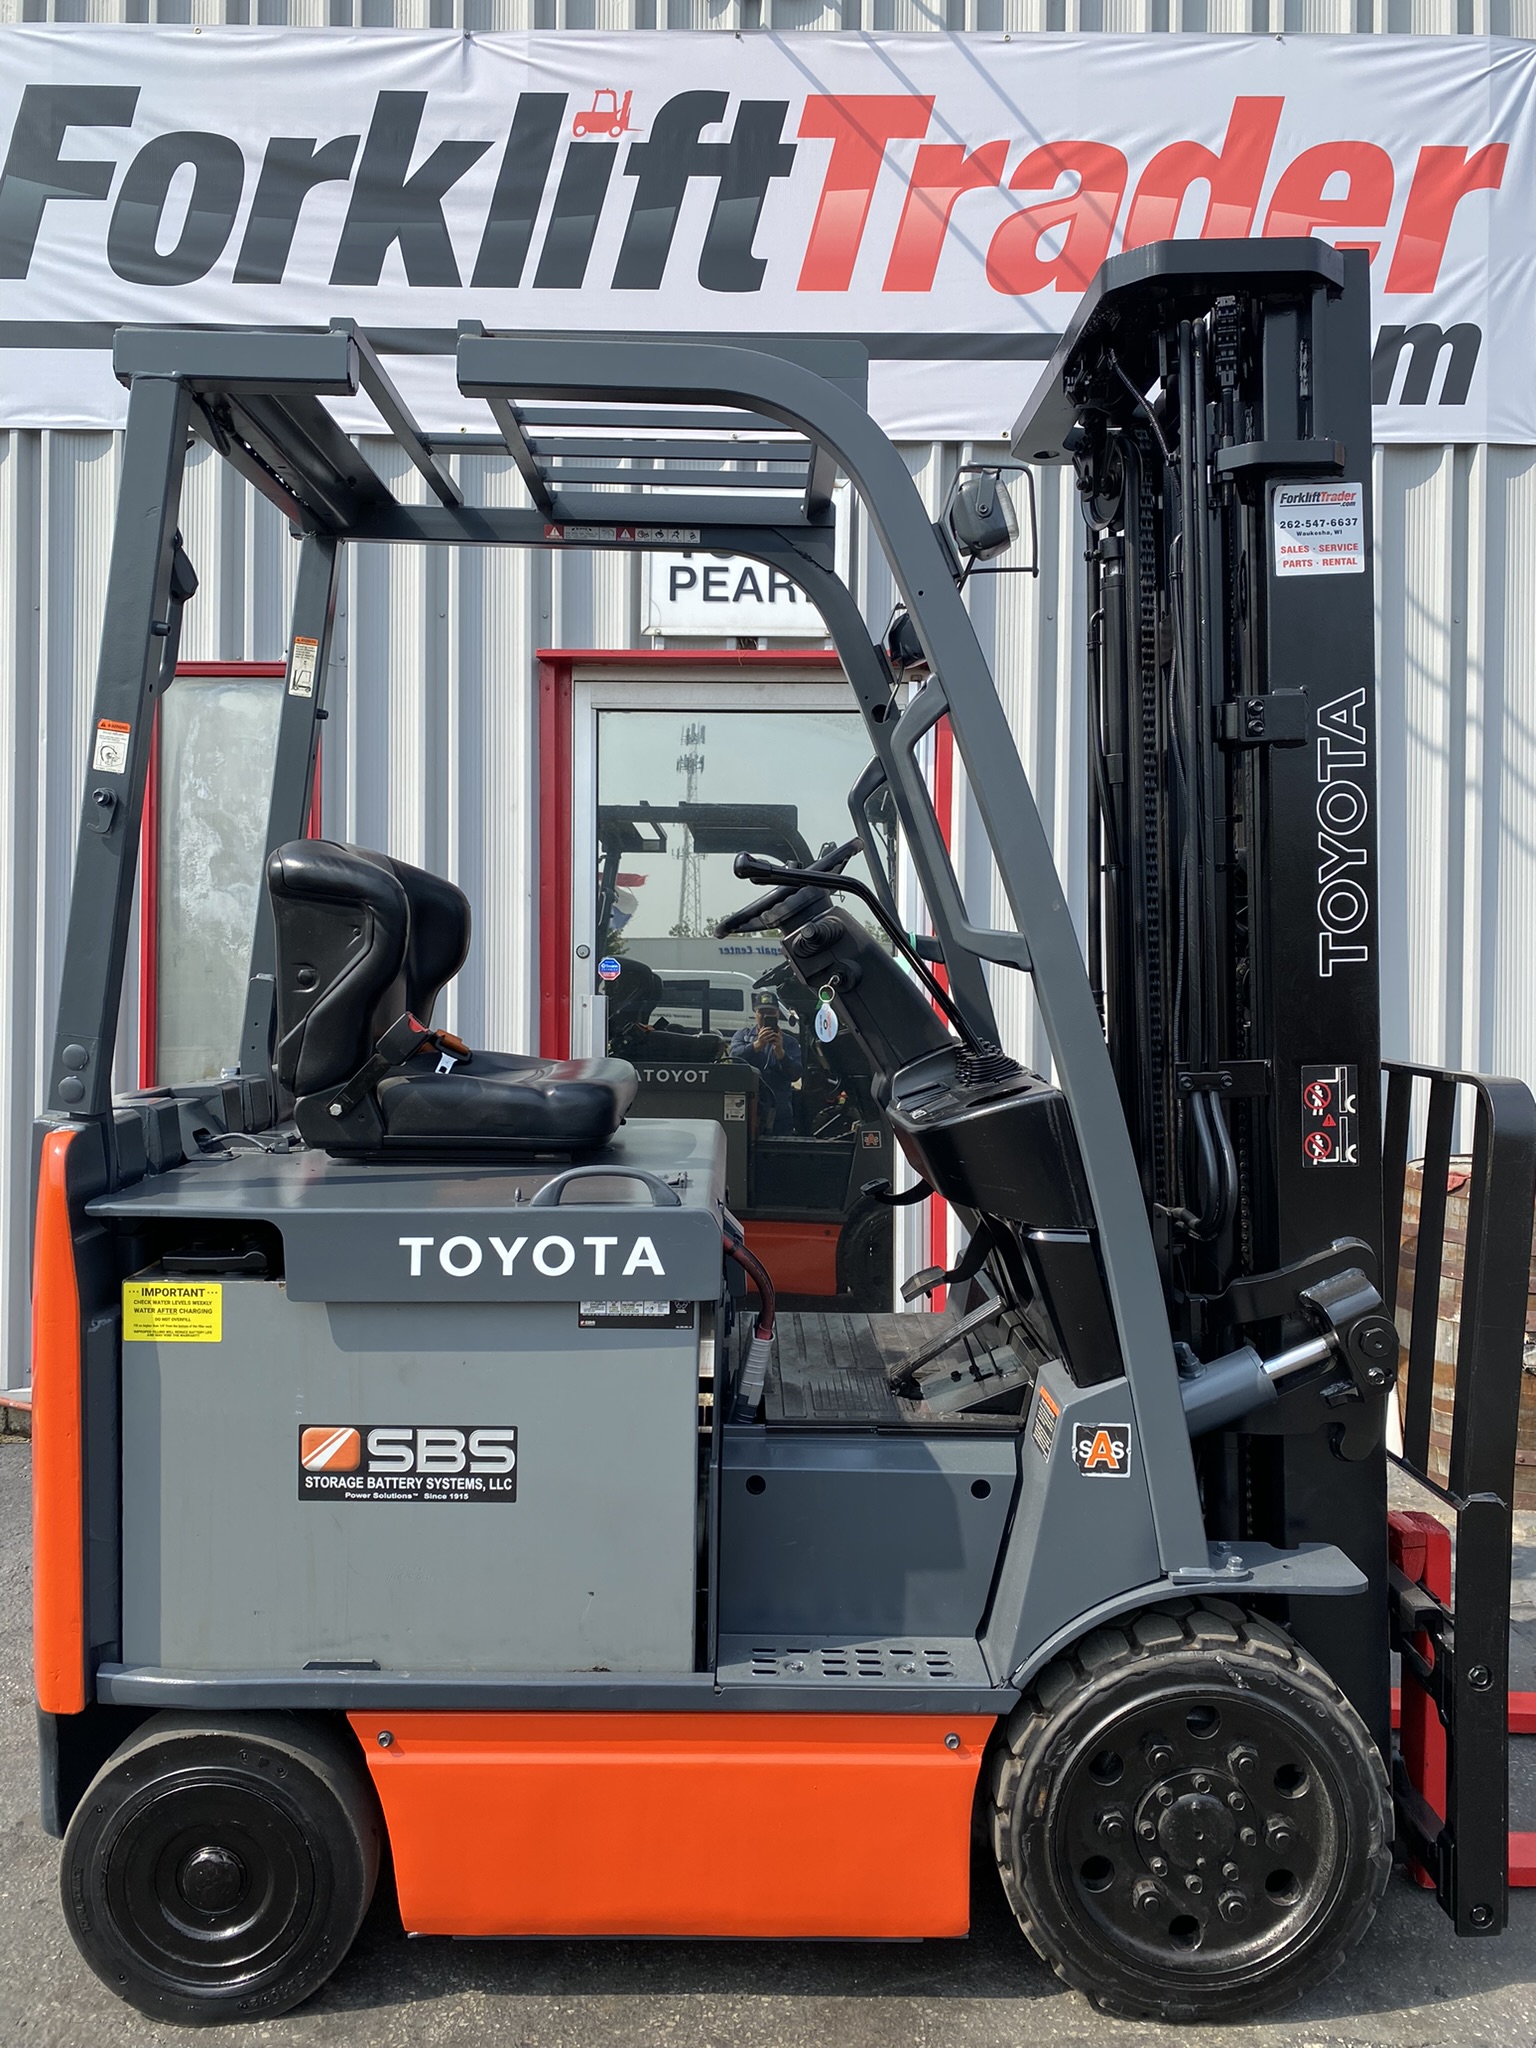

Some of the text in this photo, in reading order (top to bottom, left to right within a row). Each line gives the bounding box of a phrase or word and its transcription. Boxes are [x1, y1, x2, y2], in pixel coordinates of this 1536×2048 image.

[1279, 491, 1357, 504] ForkliftTrader
[1280, 543, 1359, 554] SALES SERVICE
[1282, 557, 1358, 568] PARTS RENTAL
[669, 565, 812, 602] PEAR
[1316, 687, 1369, 977] TOYOTA
[398, 1235, 666, 1277] TOYOTA
[141, 1287, 206, 1297] IMPORTANT
[367, 1428, 516, 1473] SBS
[305, 1476, 513, 1491] STORAGE BATTERY SYSTEMS, LLC
